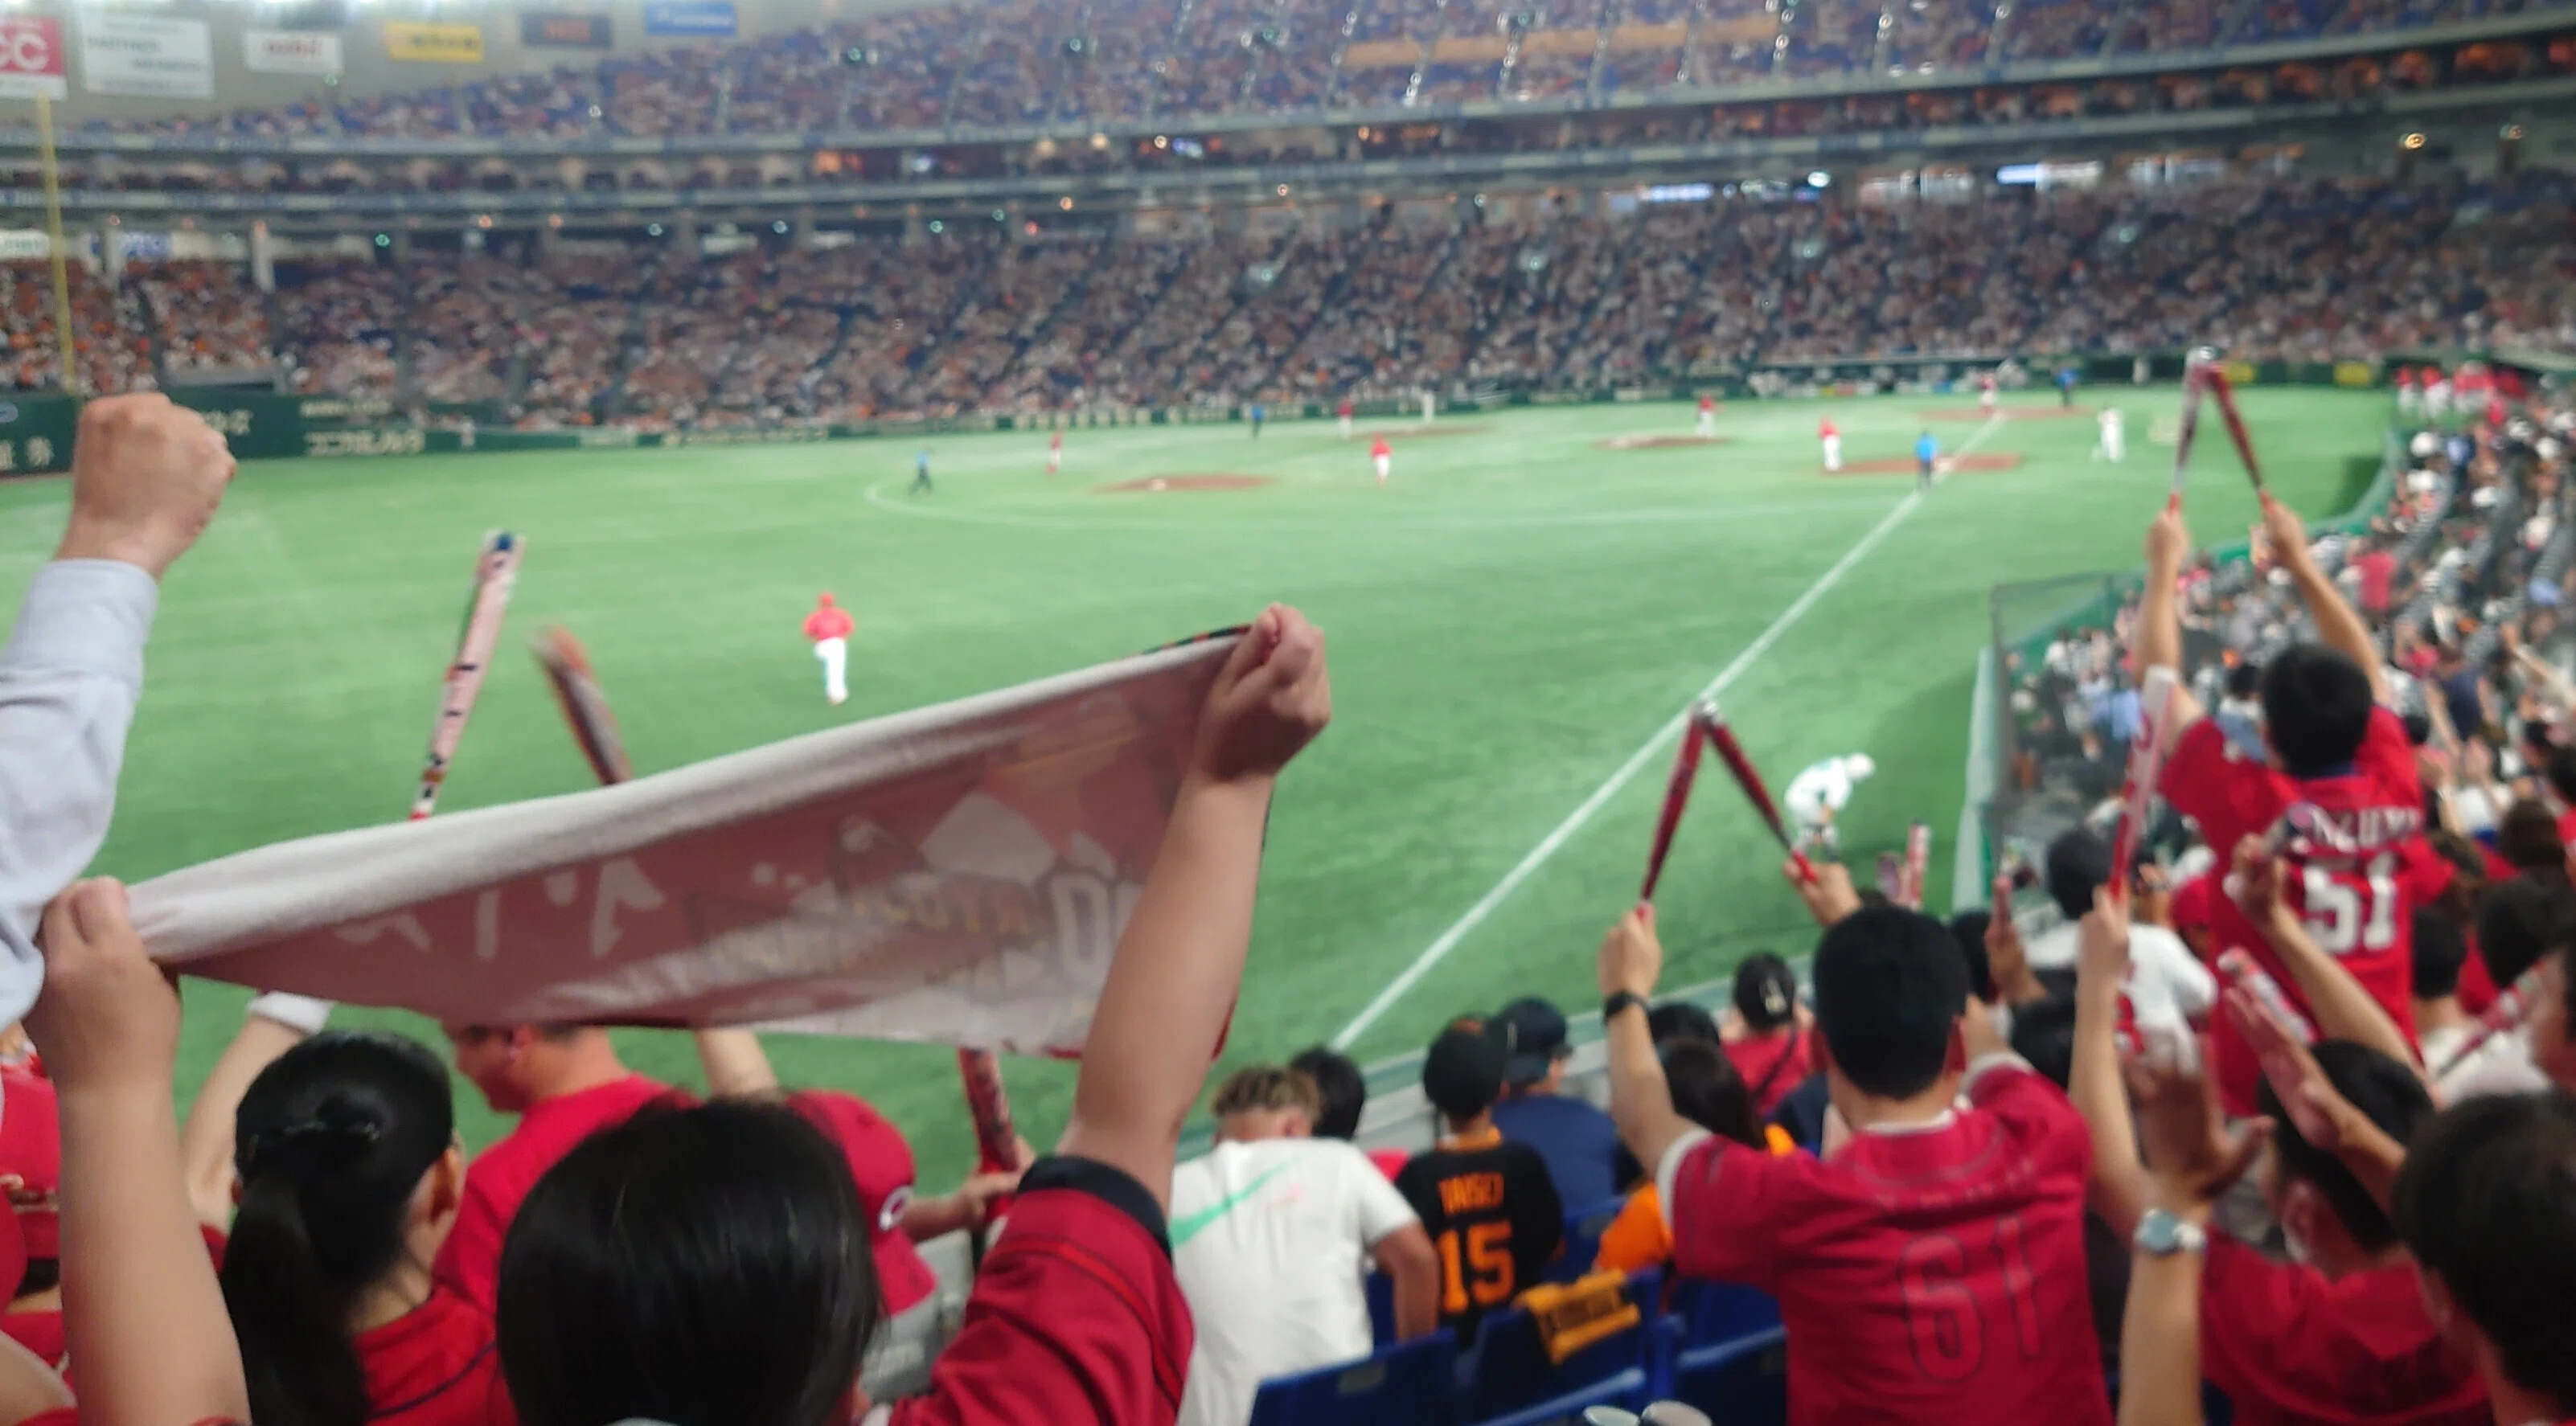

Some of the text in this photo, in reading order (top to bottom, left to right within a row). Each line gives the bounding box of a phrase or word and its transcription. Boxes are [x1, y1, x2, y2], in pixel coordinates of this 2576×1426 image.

[2302, 850, 2397, 954] 51
[1438, 1219, 1515, 1313] 15
[1899, 1212, 2041, 1384] 61
